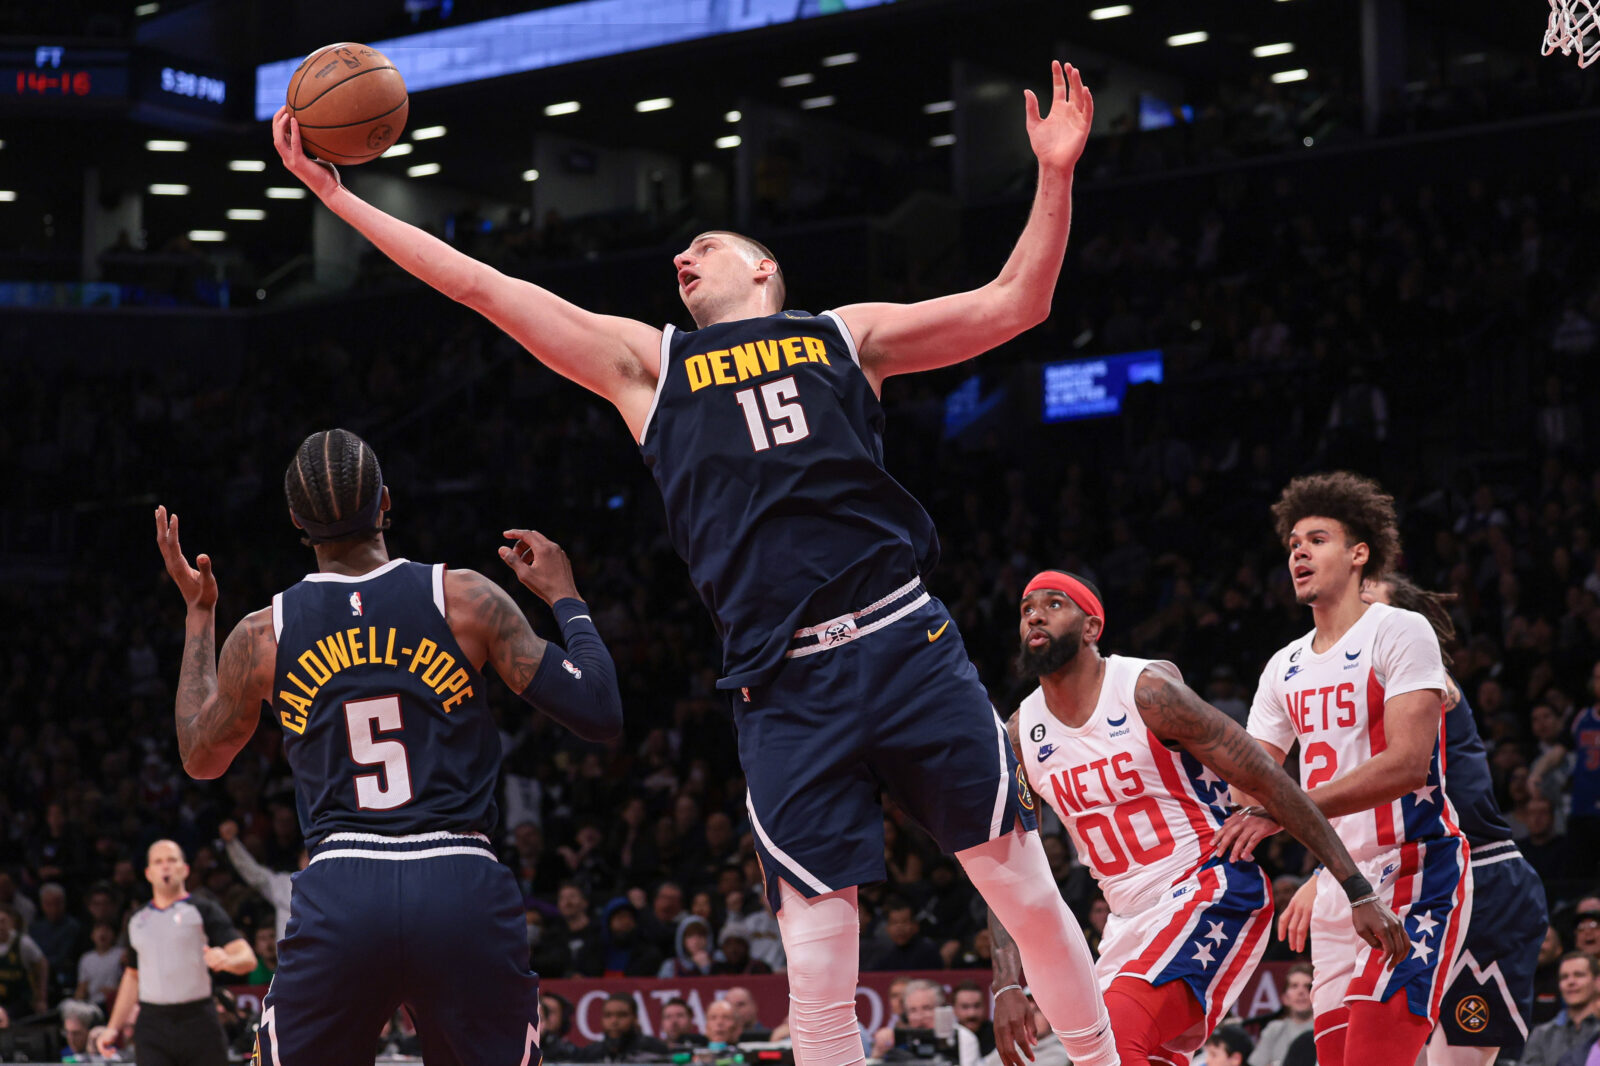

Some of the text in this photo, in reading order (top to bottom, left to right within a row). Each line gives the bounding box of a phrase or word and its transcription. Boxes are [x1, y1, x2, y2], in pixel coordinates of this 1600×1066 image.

[684, 336, 831, 393] DENVER
[734, 374, 810, 452] 15
[279, 626, 474, 735] CALDWELL-POPE
[1286, 682, 1356, 735] NETS
[342, 693, 414, 812] 5
[1032, 724, 1045, 741] 6
[1109, 728, 1130, 738] Webull
[1050, 752, 1145, 816] NETS
[1304, 741, 1338, 789] 2
[1076, 796, 1176, 876] 00
[1172, 886, 1187, 898] NIKE
